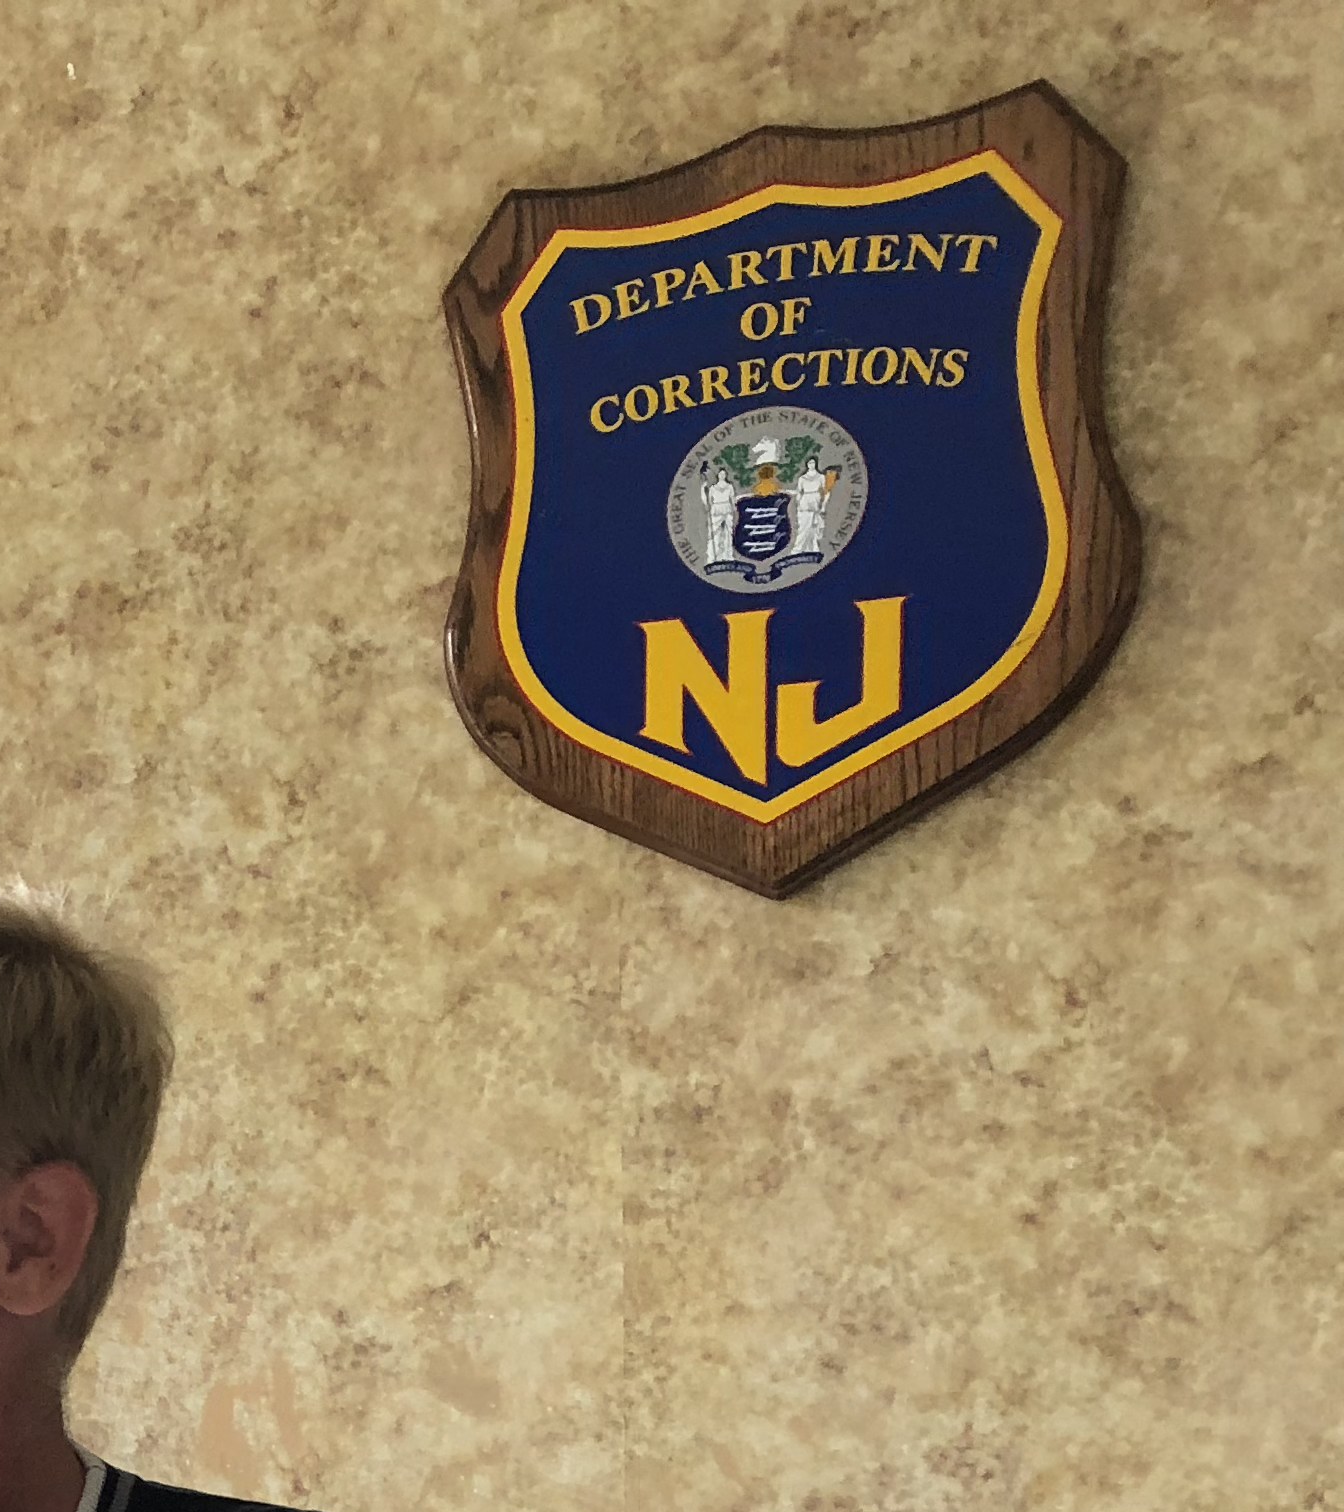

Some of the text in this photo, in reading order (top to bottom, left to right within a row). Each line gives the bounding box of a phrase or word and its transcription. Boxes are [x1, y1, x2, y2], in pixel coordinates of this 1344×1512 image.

[569, 233, 998, 335] DEPARTMENT
[739, 297, 812, 341] OF
[589, 346, 969, 434] CORRECTIONS
[671, 410, 862, 565] THE GREAT SEAL OF THE STATE OF NEW JERSEY
[638, 596, 909, 787] NJ
